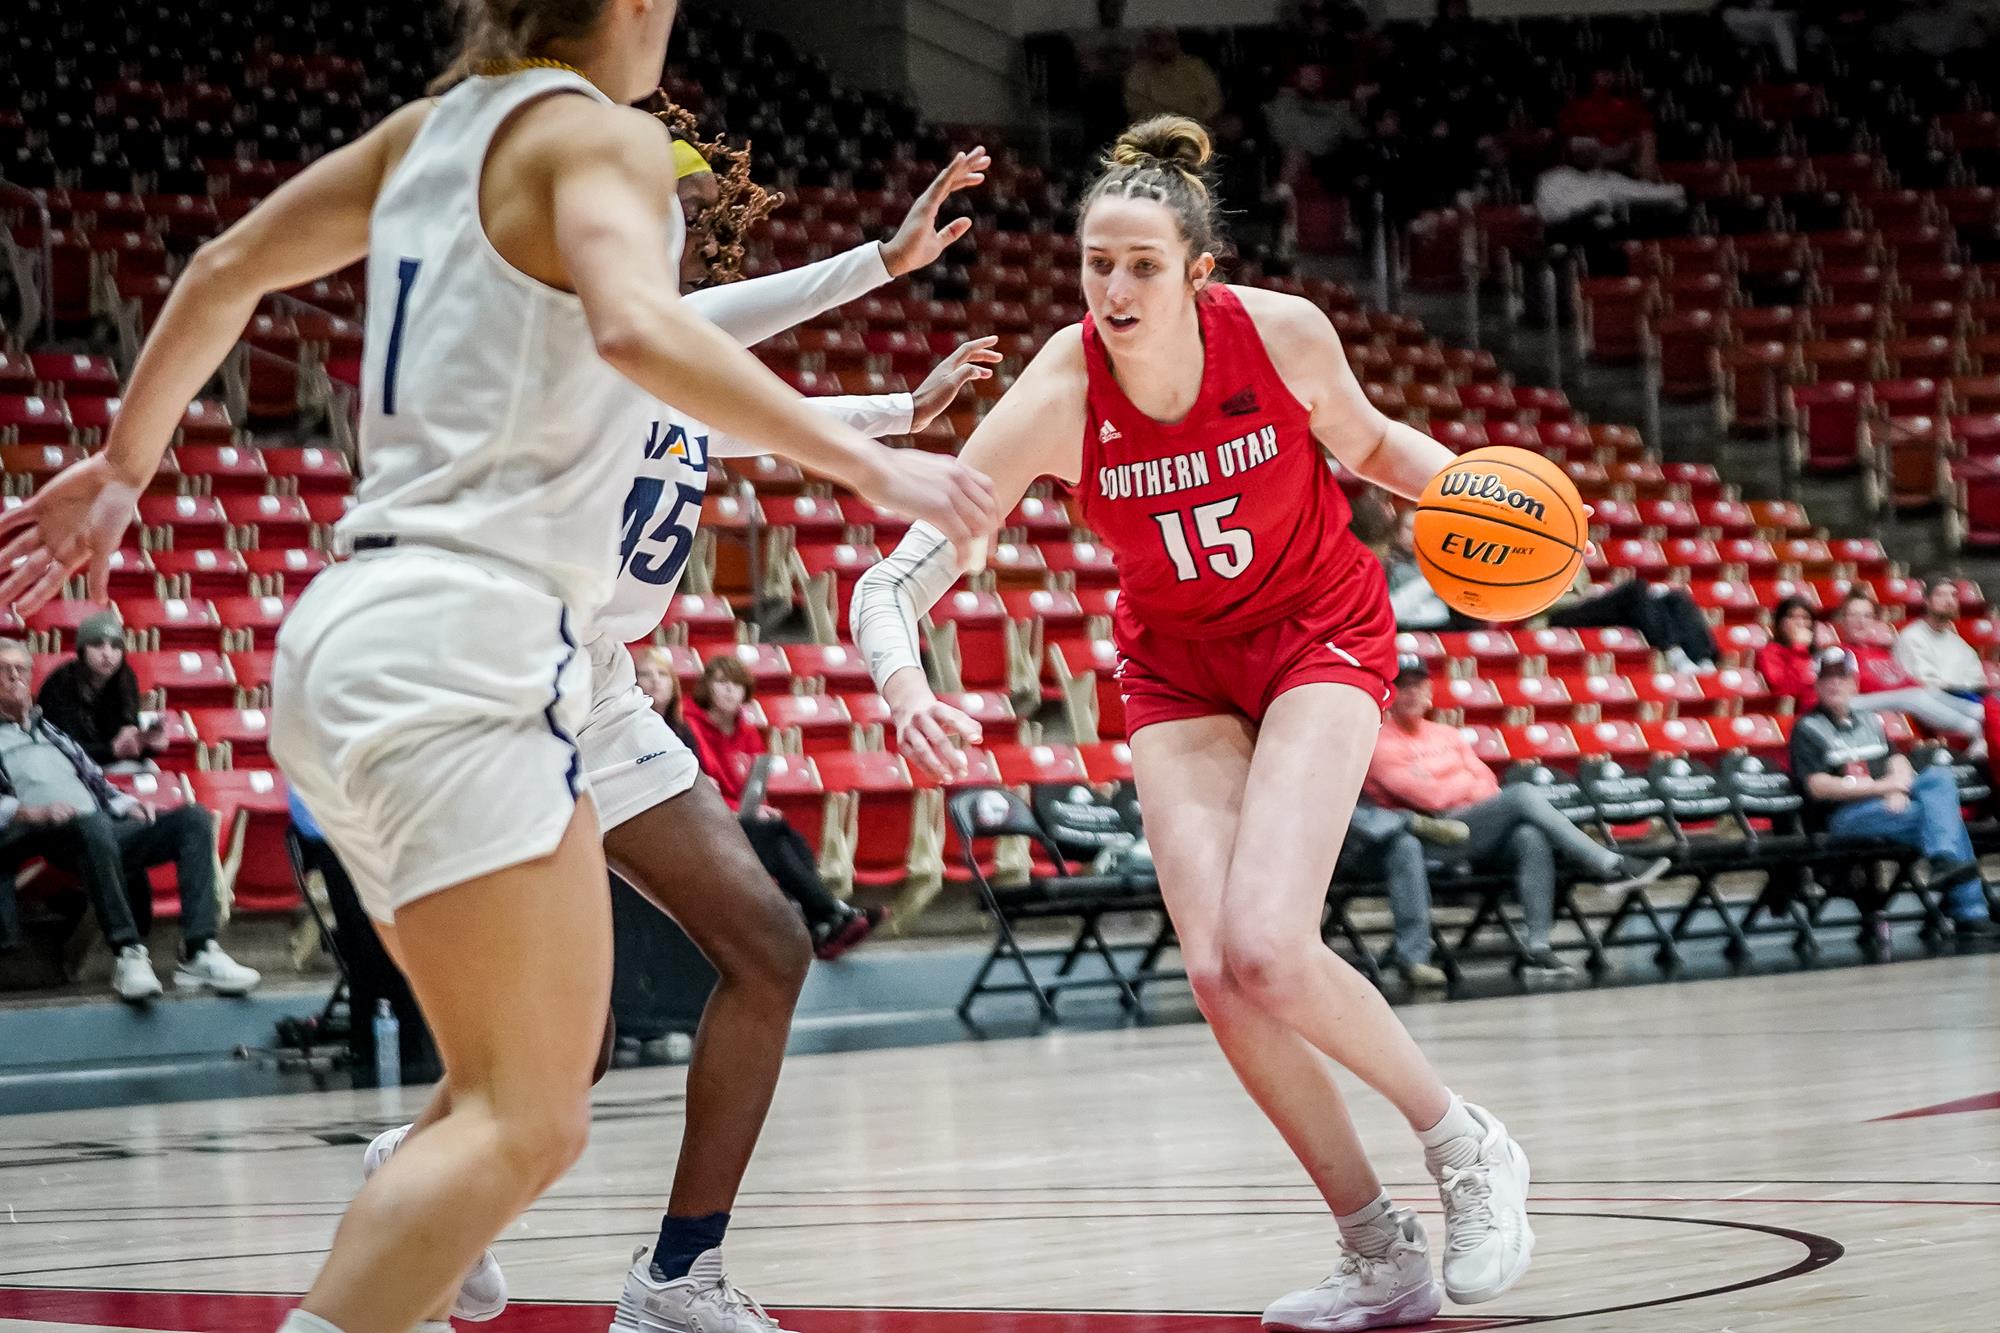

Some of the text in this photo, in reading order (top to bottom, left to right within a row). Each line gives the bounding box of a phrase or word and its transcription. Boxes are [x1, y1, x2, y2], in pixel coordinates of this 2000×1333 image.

[382, 257, 421, 415] 1
[1099, 425, 1279, 500] SOUTHERN UTAH
[1440, 471, 1545, 522] Wilson
[617, 477, 705, 585] 45
[1150, 494, 1255, 582] 15
